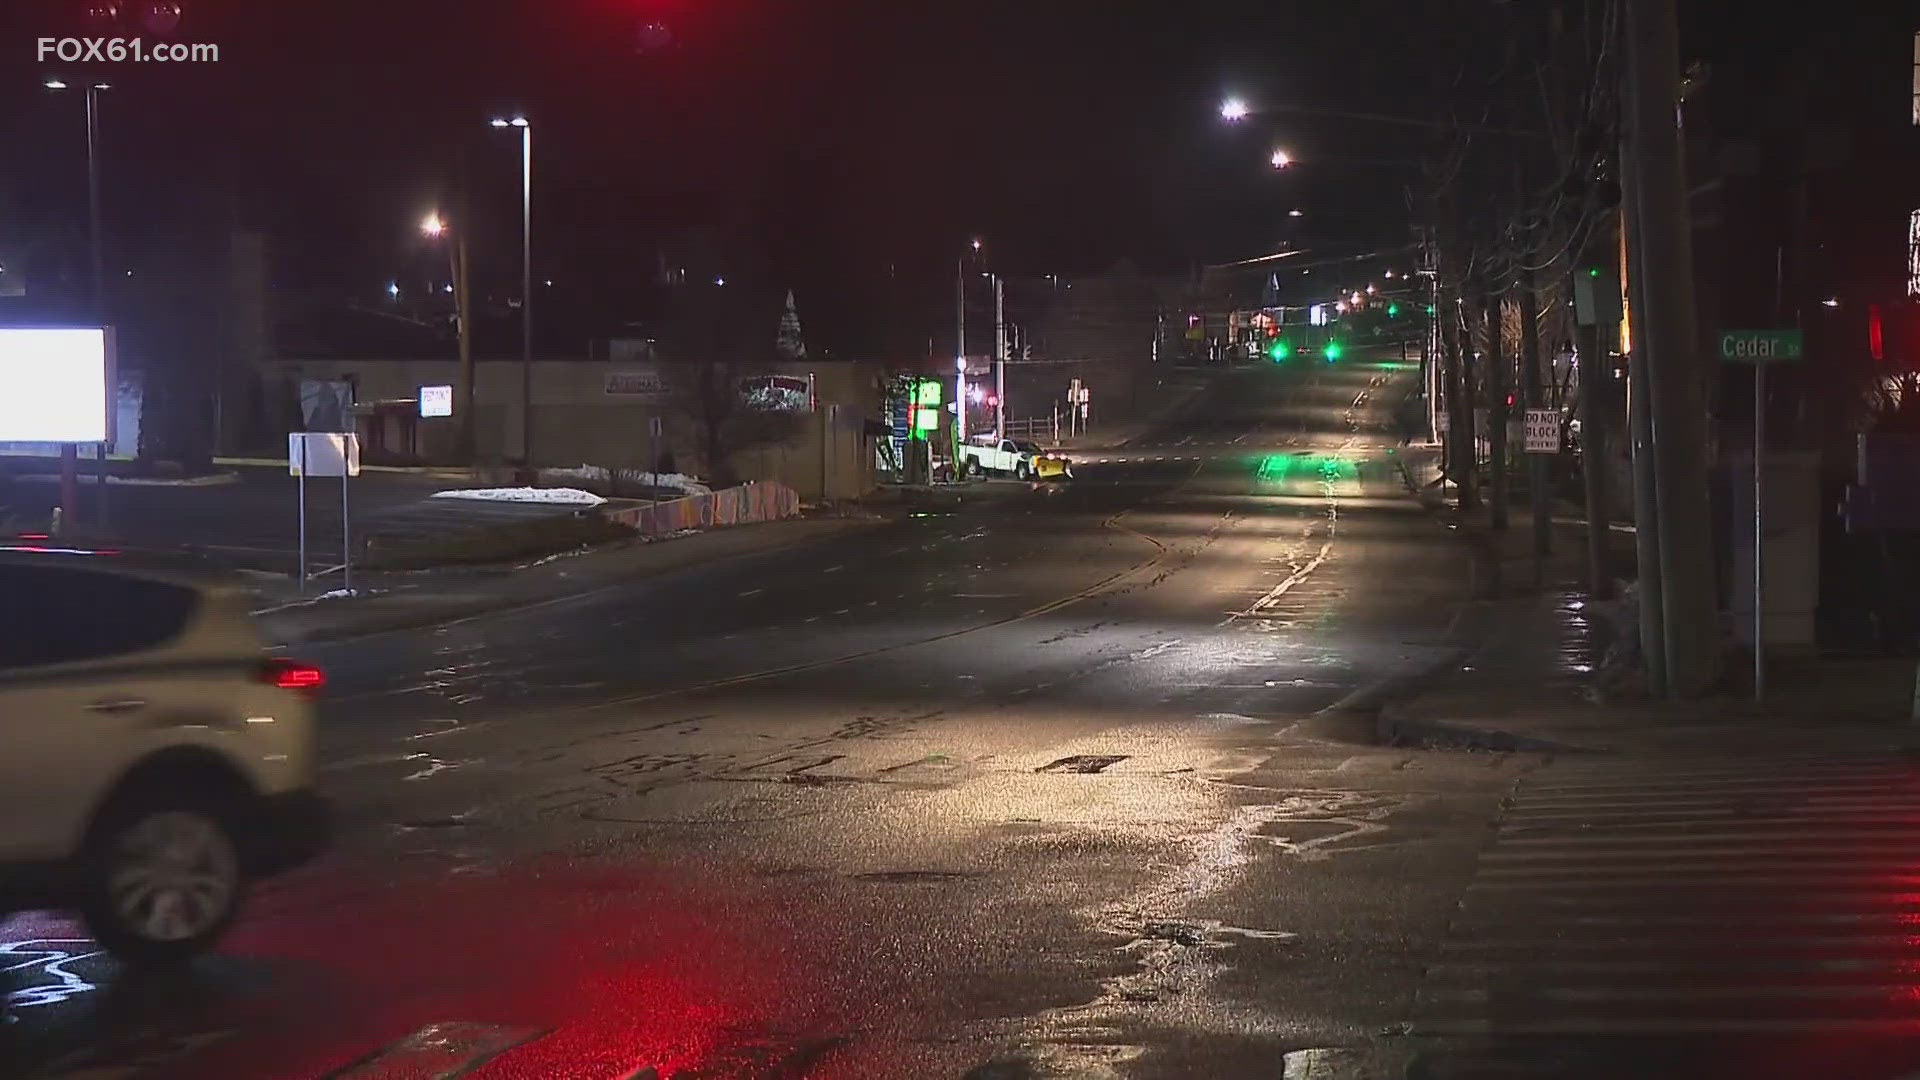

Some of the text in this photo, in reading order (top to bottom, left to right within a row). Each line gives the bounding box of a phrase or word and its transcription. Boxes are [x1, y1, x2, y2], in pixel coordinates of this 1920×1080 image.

[1722, 334, 1779, 357] Cedar
[1526, 413, 1558, 424] DO NOT
[1526, 427, 1557, 437] BLOCK
